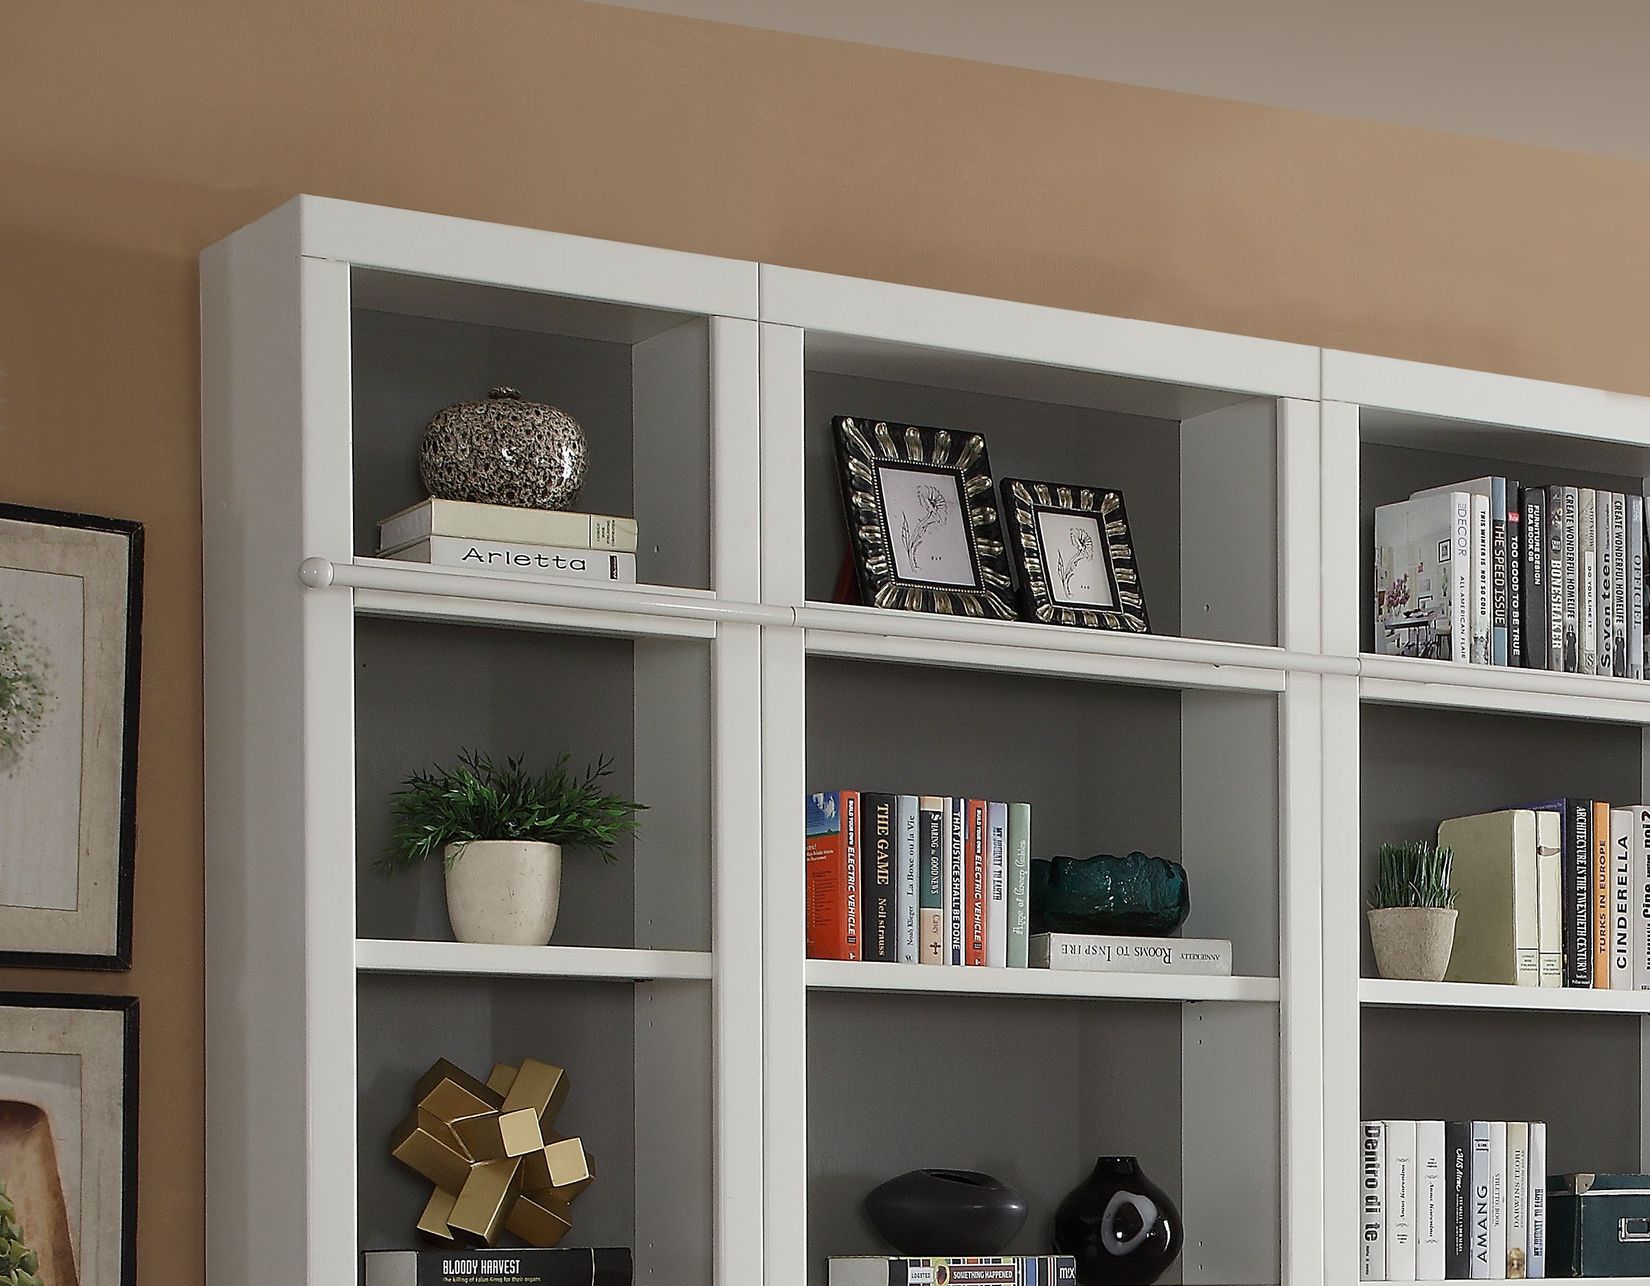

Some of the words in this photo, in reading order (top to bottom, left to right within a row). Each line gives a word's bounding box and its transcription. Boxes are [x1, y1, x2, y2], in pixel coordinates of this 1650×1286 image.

[1566, 494, 1574, 523] CREATE
[1614, 500, 1623, 529] CREATE
[1457, 508, 1467, 556] DECOR
[1495, 524, 1504, 547] THE
[461, 547, 586, 571] Arletta
[1566, 526, 1574, 576] WONDERFUL
[1614, 531, 1623, 581] WONDERFUL
[1495, 550, 1505, 586] SPEED
[1511, 560, 1519, 591] GOOD
[1495, 588, 1505, 624] ISSUE
[1512, 593, 1519, 609] TO
[1551, 559, 1561, 649] BONESHAKER
[1566, 578, 1574, 619] HOMELIFE
[1614, 583, 1623, 624] HOMELIFE
[1633, 554, 1642, 629] OFFICIEL
[1512, 611, 1519, 625] BE
[1512, 627, 1520, 656] TRUE
[877, 803, 889, 836] THE
[952, 811, 960, 836] THAT
[877, 838, 889, 885] GAME
[952, 837, 960, 876] JUSTICE
[952, 877, 960, 907] SHALL
[974, 854, 982, 899] ELECTRIC
[1576, 875, 1587, 891] THE
[952, 909, 960, 921] BE
[1599, 895, 1606, 909] IN
[1616, 835, 1628, 969] CINDERELLA
[952, 922, 960, 950] DONE
[974, 901, 982, 941] VEHICLE
[1364, 1125, 1381, 1189] Dentro
[1364, 1195, 1381, 1213] di
[1364, 1222, 1381, 1242] te
[1476, 1185, 1487, 1264] AMANG
[443, 1259, 479, 1274] BLOODY
[481, 1259, 521, 1274] HARVEST
